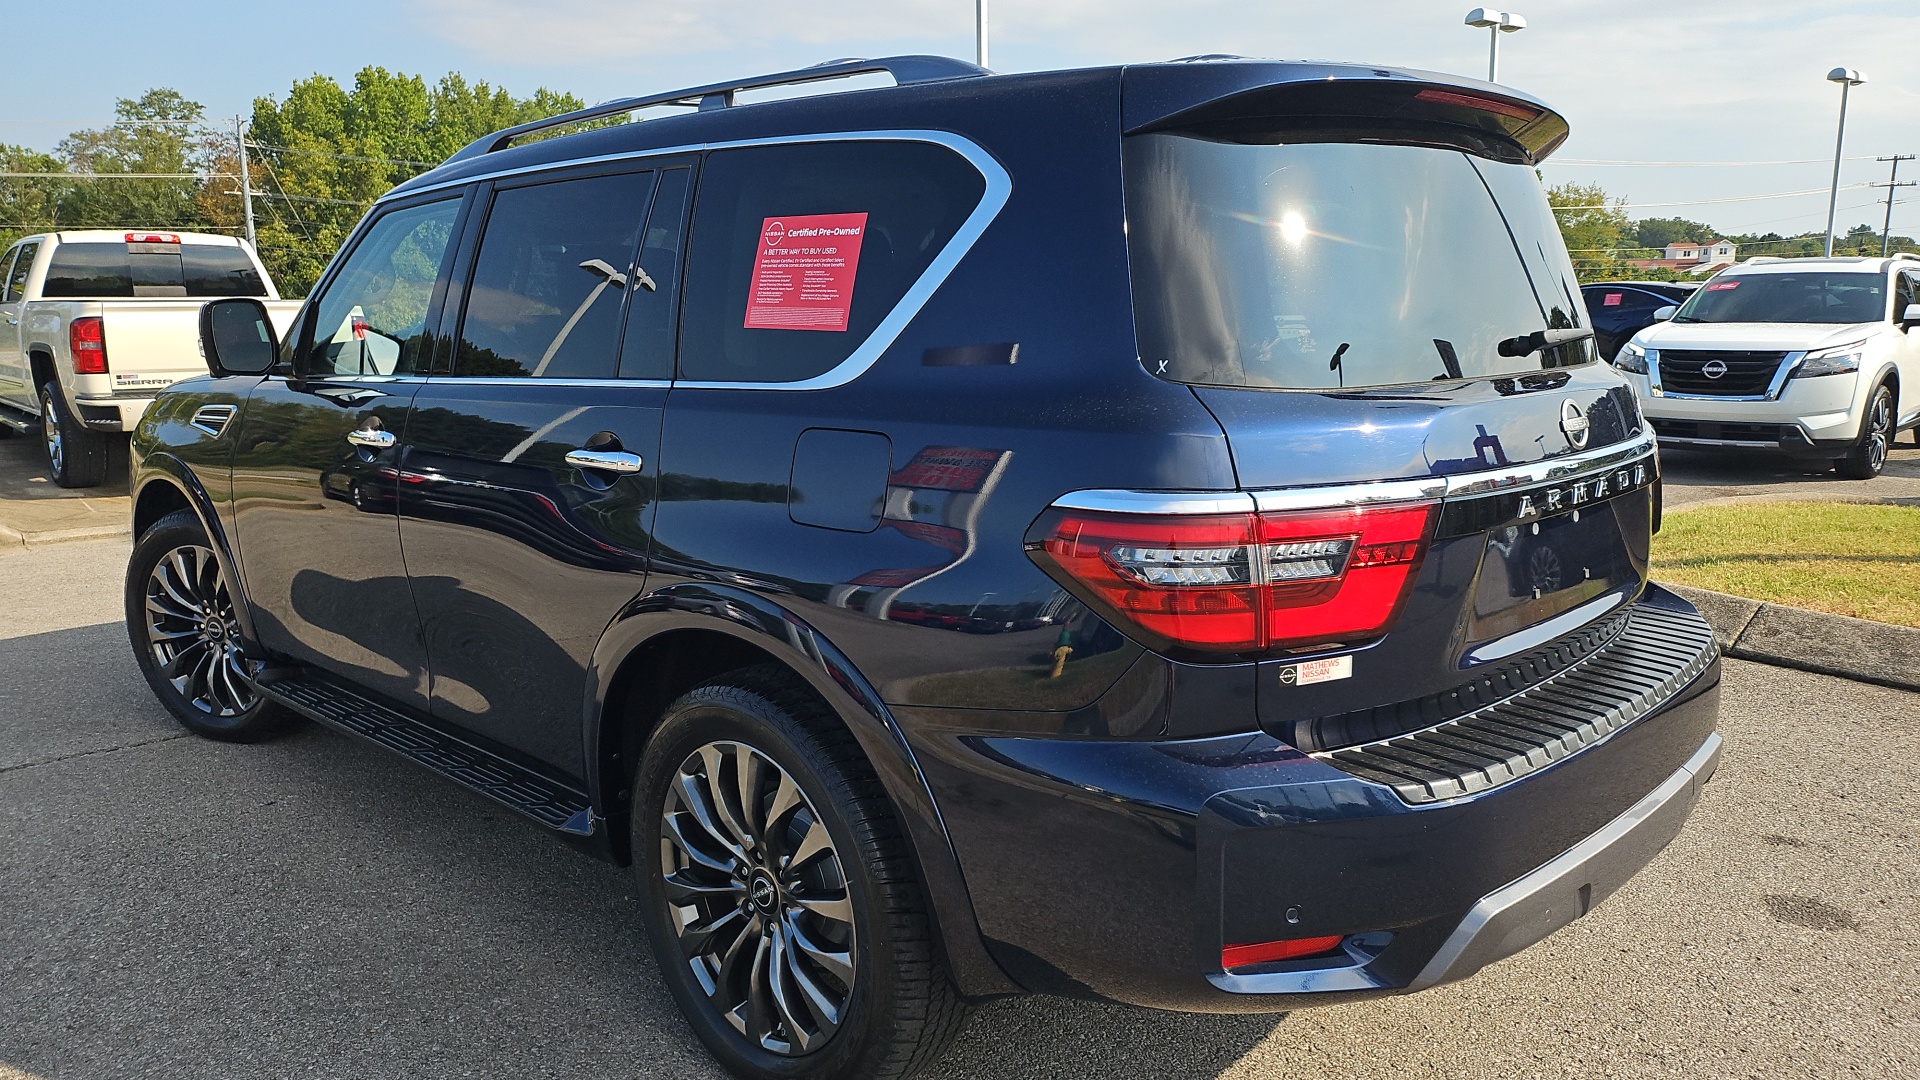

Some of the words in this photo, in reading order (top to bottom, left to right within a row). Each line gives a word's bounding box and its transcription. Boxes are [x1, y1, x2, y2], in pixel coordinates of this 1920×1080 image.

[787, 228, 818, 237] Certified
[818, 226, 861, 236] Pre-Owned
[768, 248, 789, 256] BETTER
[822, 247, 838, 255] USED
[1516, 464, 1646, 519] ARMADA
[1302, 659, 1340, 671] MATHEWS
[1302, 668, 1330, 678] NISSAN
